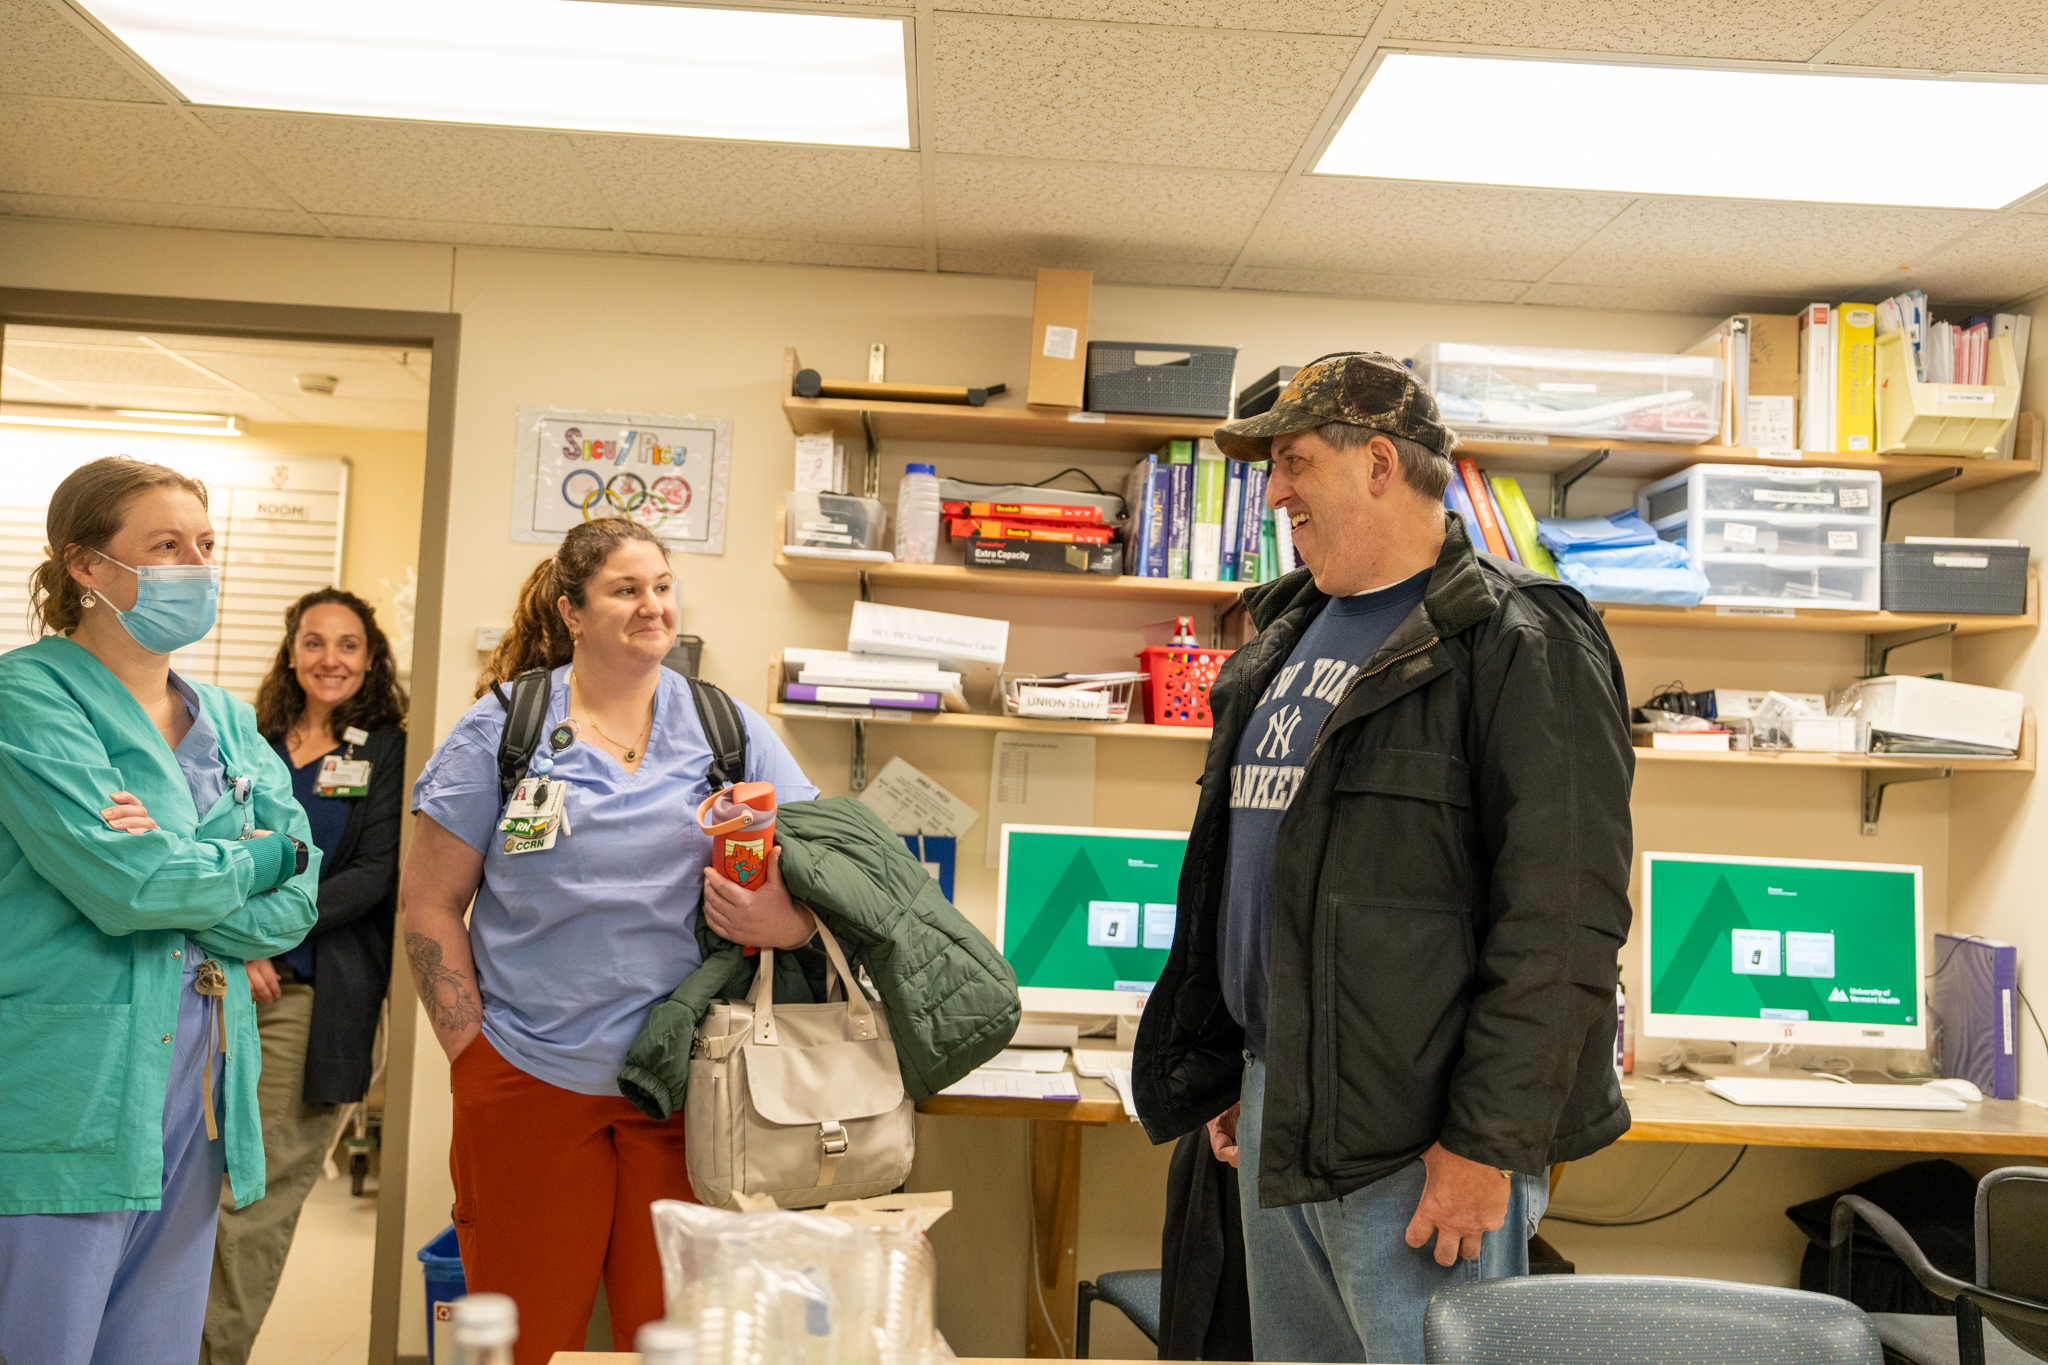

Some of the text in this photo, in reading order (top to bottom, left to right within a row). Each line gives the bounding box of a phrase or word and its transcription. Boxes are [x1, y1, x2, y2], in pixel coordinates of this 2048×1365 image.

[257, 502, 304, 516] ROOM
[996, 504, 1020, 513] Scotch
[1006, 528, 1030, 537] Scotch
[975, 549, 1030, 561] Extra Capacity
[1028, 697, 1065, 708] UNION
[516, 822, 531, 832] RN
[516, 839, 544, 850] CCRN
[1850, 987, 1882, 996] University
[1850, 995, 1900, 1005] Vermont Health
